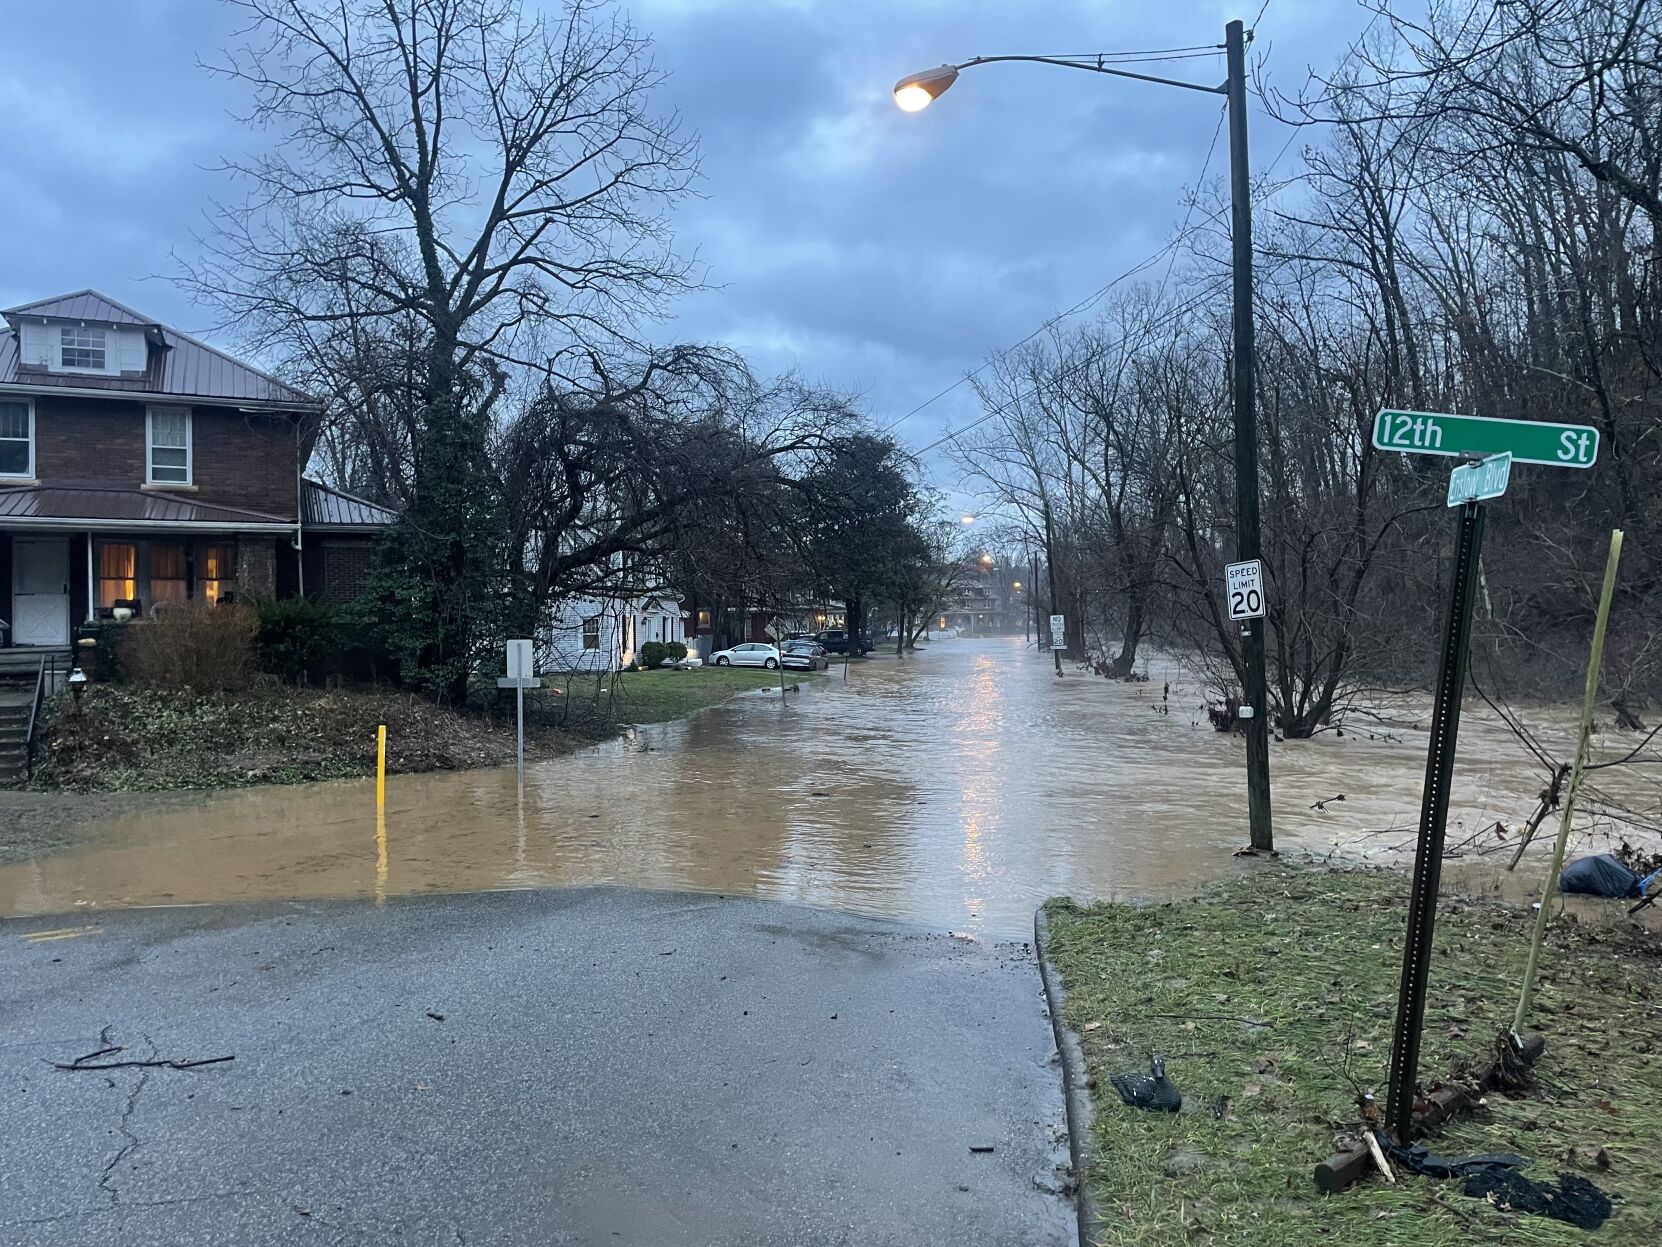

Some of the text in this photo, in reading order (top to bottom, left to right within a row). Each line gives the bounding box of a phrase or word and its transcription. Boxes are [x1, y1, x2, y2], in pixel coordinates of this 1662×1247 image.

[1384, 415, 1590, 462] 12th St
[1484, 458, 1508, 493] Blvd
[1230, 567, 1257, 578] SPEED
[1233, 579, 1255, 589] LIMIT
[1232, 589, 1260, 614] 20
